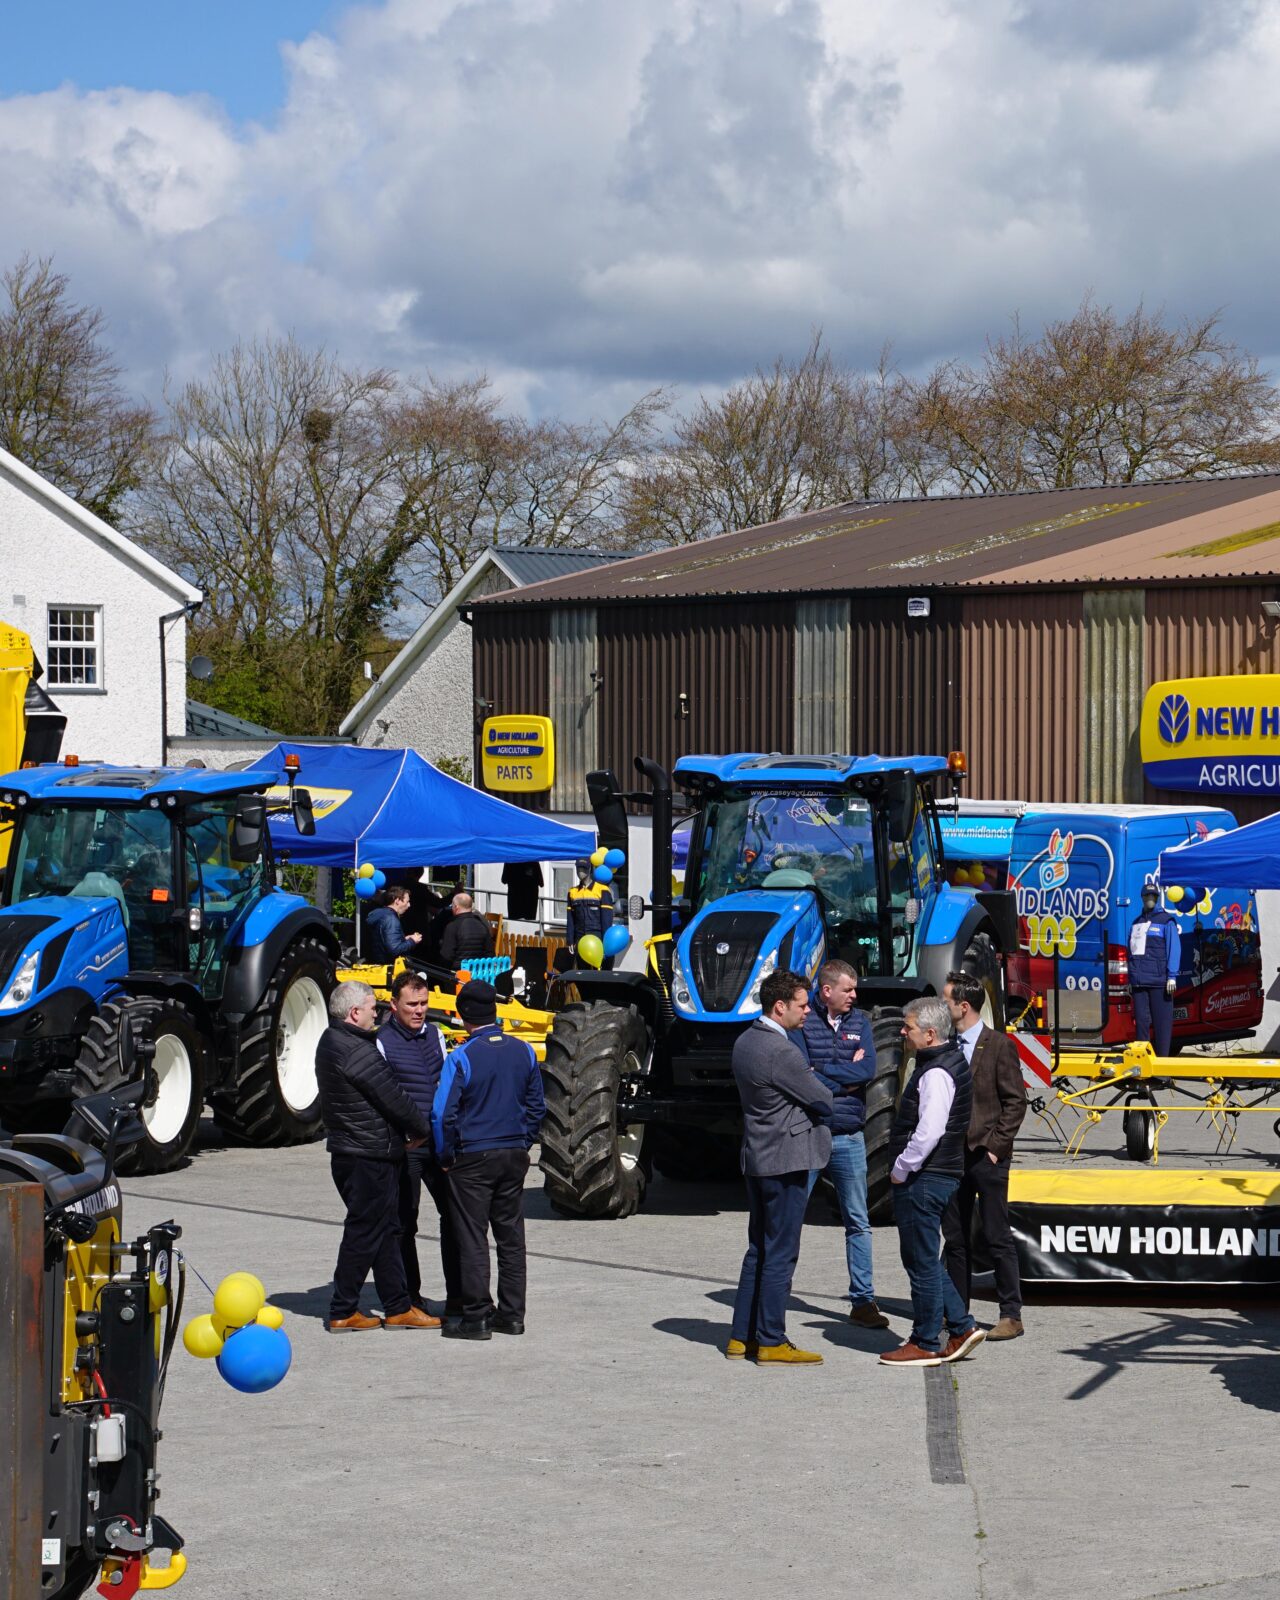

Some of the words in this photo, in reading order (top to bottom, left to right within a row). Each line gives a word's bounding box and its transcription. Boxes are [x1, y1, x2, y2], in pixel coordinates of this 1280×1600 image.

[1196, 706, 1255, 736] NEW
[496, 765, 533, 780] PARTS
[1027, 915, 1077, 958] 103
[82, 1185, 119, 1217] HOLLAND
[1040, 1225, 1122, 1253] NEW
